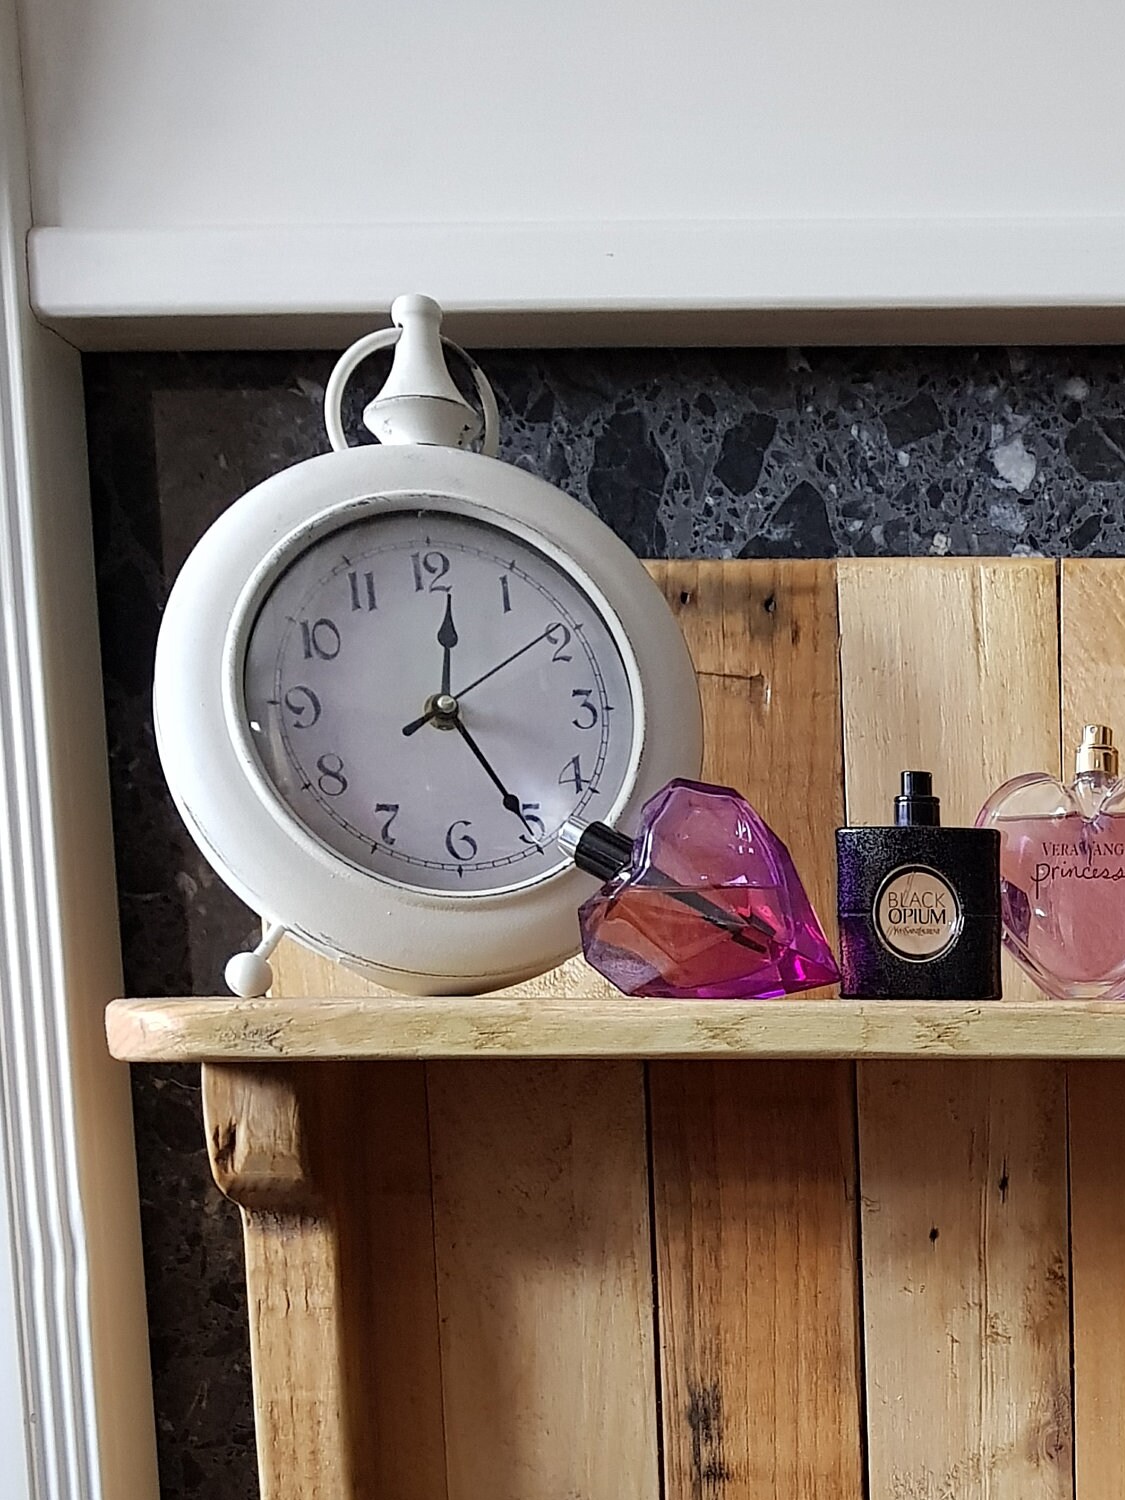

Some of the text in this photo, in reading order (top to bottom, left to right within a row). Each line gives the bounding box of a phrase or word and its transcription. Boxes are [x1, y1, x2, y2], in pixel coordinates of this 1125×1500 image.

[347, 571, 377, 611] 11
[411, 551, 452, 593] 12
[499, 575, 513, 612] 1
[302, 617, 340, 660] 10
[544, 622, 573, 662] 2
[284, 685, 321, 728] 9
[571, 689, 598, 730] 3
[316, 753, 348, 796] 8
[558, 754, 590, 794] 4
[375, 803, 400, 845] 7
[445, 820, 478, 861] 6
[519, 802, 546, 844] 5
[1042, 842, 1078, 857] VERA
[888, 891, 946, 908] BLACK
[888, 907, 946, 925] OPIUM
